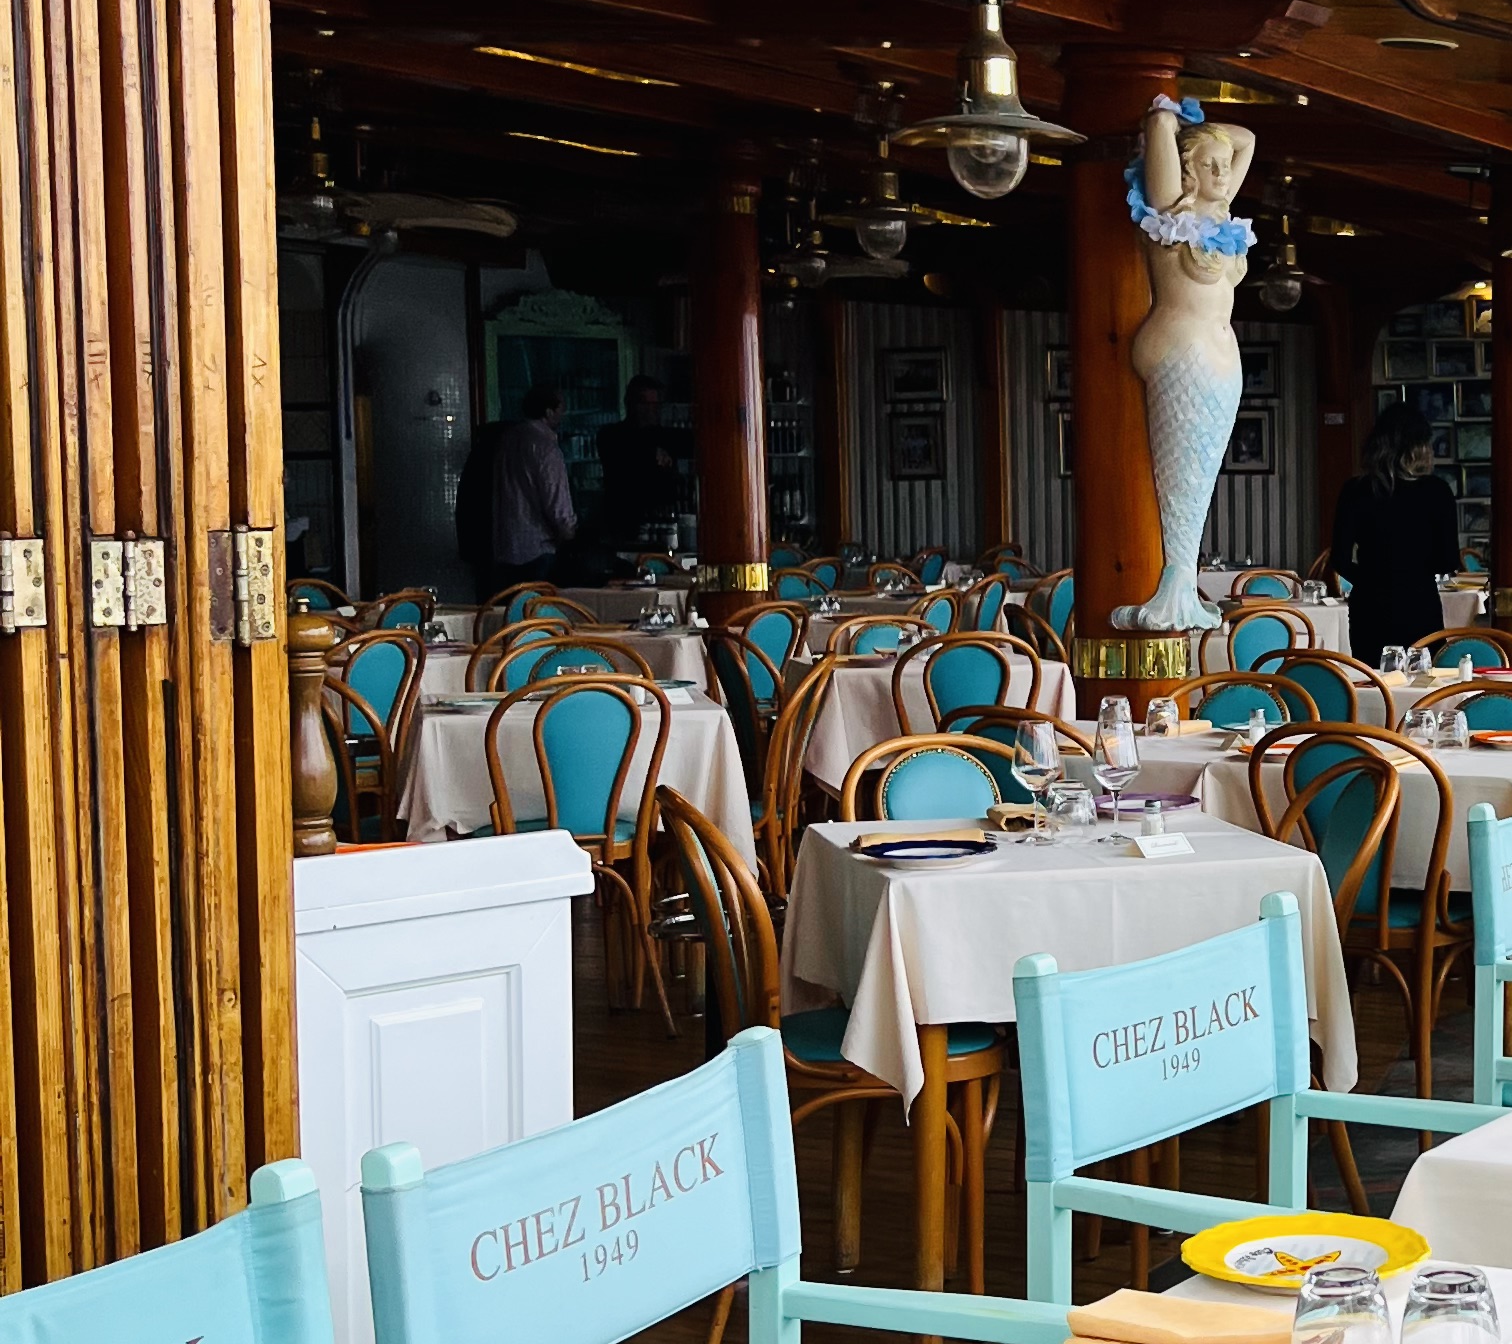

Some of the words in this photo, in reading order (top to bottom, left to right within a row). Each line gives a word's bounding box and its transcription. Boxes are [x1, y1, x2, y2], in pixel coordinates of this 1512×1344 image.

[1092, 1015, 1166, 1069] CHEZ
[1172, 985, 1260, 1046] BLACK
[1162, 1047, 1201, 1081] 1949
[470, 1195, 586, 1282] CHEZ
[595, 1131, 725, 1233] BLACK
[581, 1228, 640, 1283] 1949
